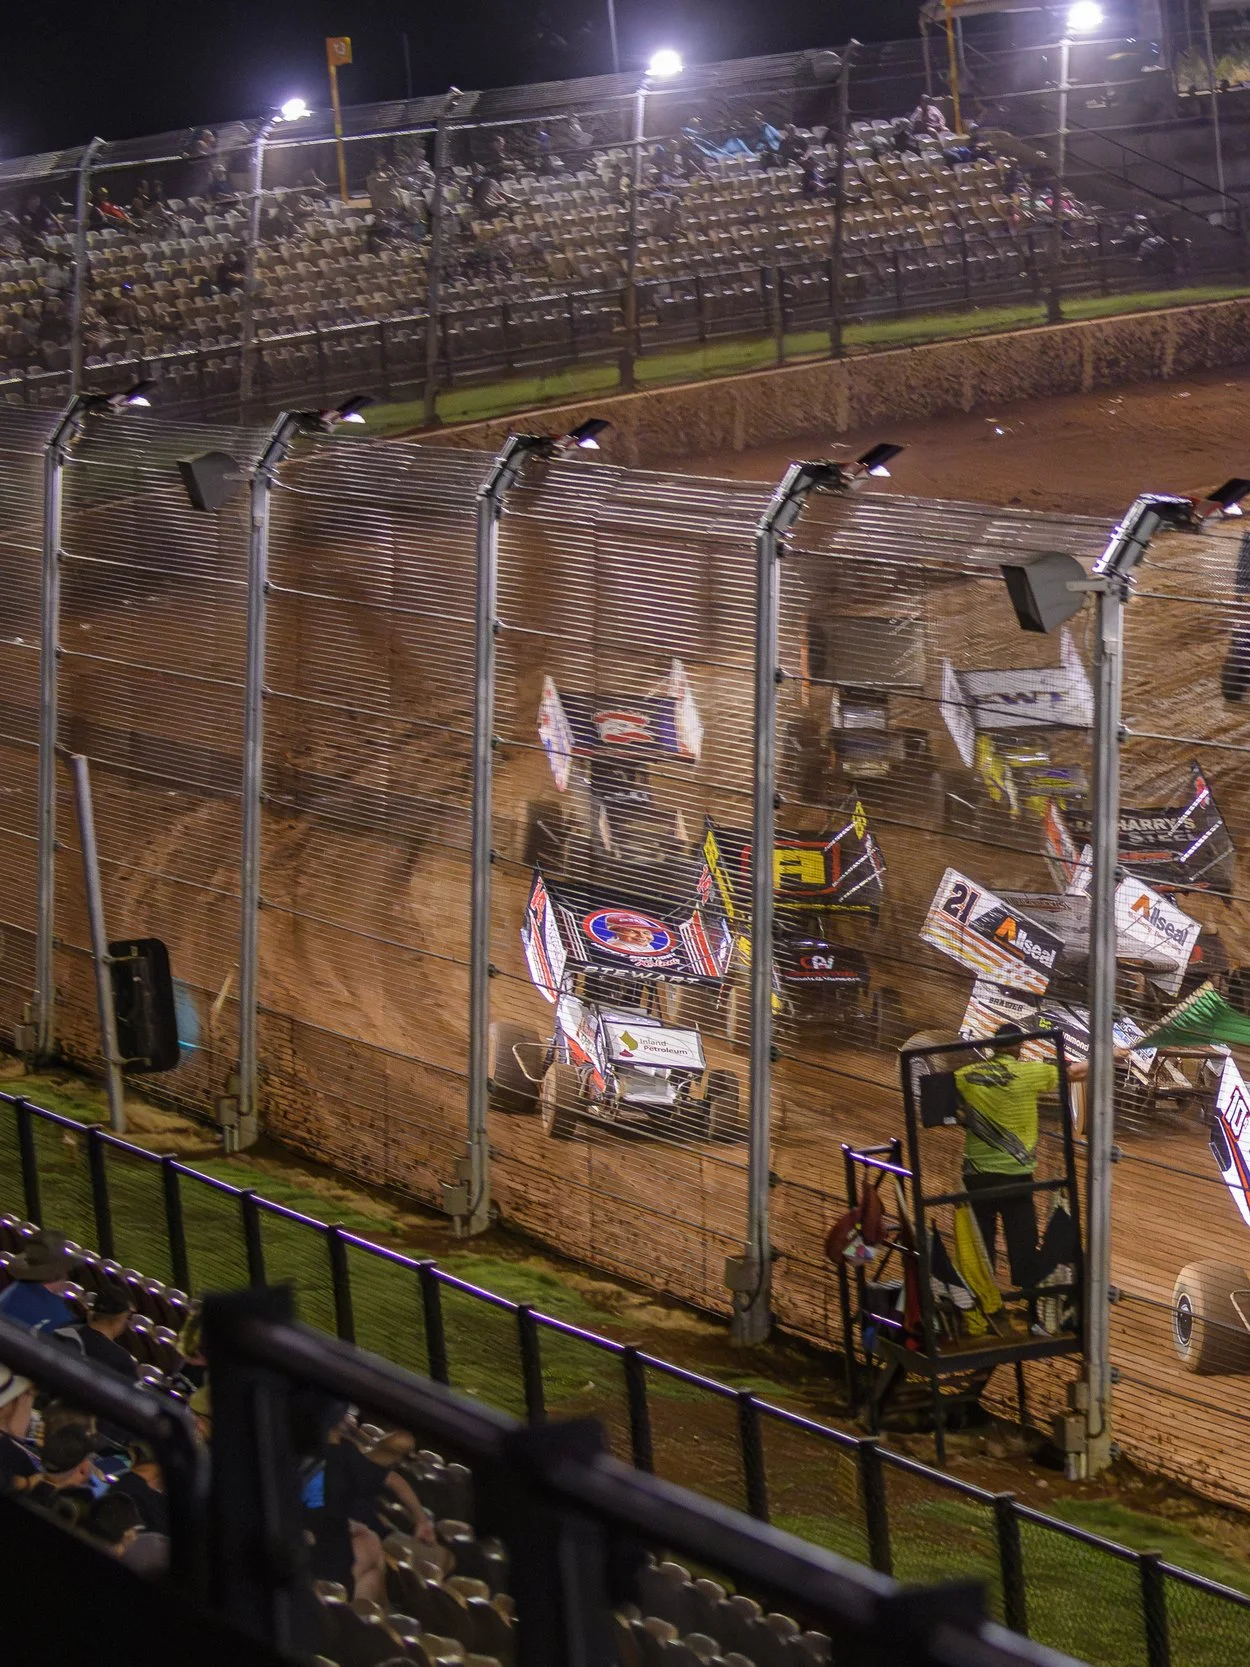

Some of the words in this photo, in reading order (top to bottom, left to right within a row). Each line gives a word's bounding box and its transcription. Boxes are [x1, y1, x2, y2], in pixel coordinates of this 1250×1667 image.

[941, 880, 981, 926] 21
[1131, 893, 1188, 947] Allseal
[994, 916, 1056, 968] Allseal
[584, 965, 700, 984] STEWART
[640, 1037, 667, 1046] Inland
[644, 1045, 688, 1055] Petroleum
[1224, 1086, 1250, 1141] 10
